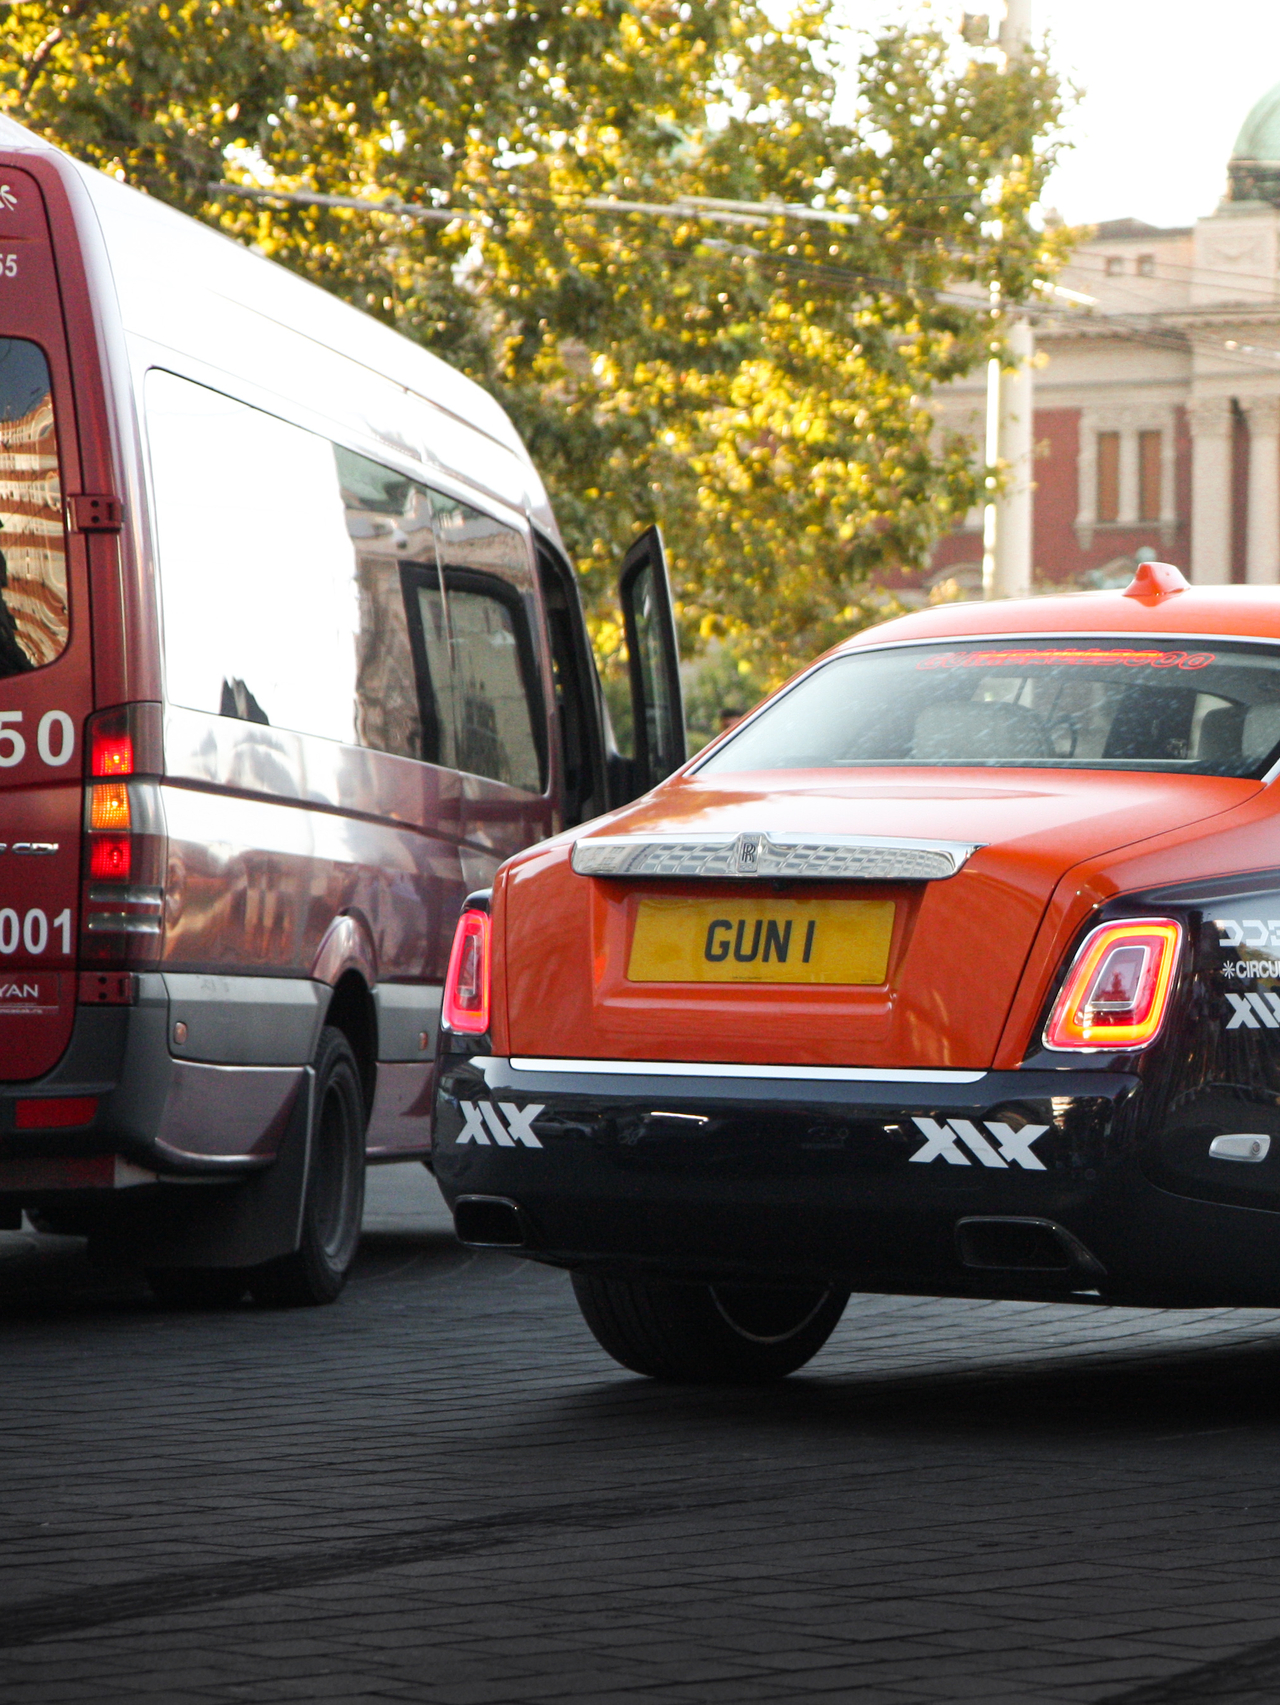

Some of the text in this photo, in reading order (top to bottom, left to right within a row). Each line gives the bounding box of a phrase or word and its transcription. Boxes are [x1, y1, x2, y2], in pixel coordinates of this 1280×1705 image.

[0, 253, 18, 277] 5
[0, 709, 75, 768] 50
[0, 907, 71, 955] 001
[704, 918, 793, 964] GUN
